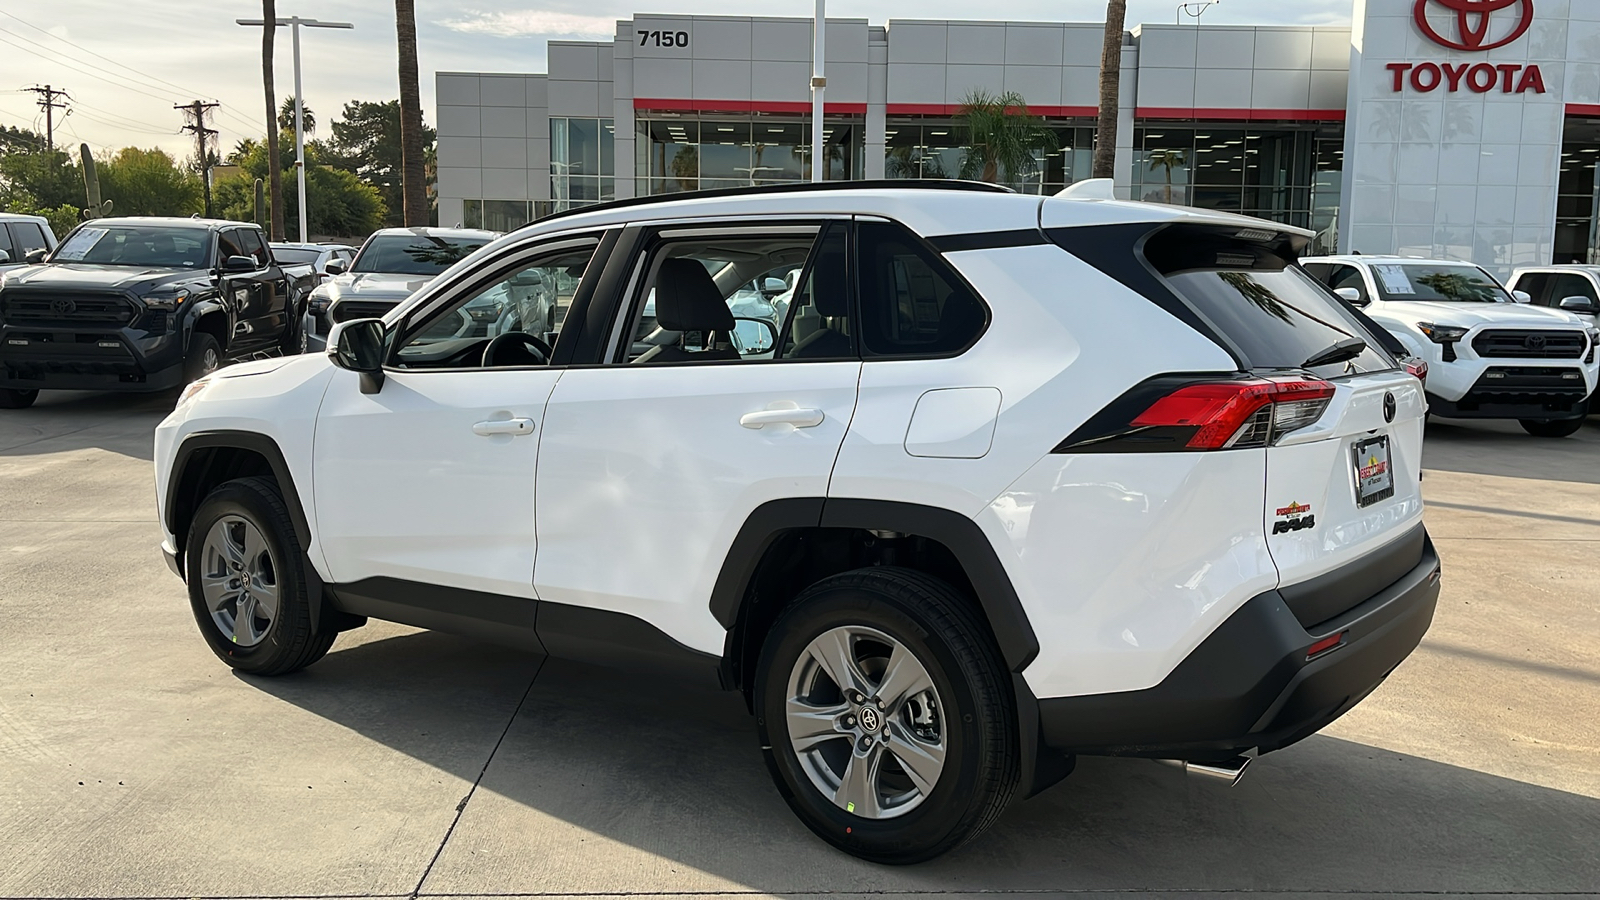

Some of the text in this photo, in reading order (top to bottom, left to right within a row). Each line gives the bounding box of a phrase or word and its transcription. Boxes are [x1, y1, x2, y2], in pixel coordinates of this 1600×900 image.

[637, 30, 689, 47] 7150
[1386, 62, 1546, 94] TOYOTA
[1272, 514, 1315, 535] RAV4
